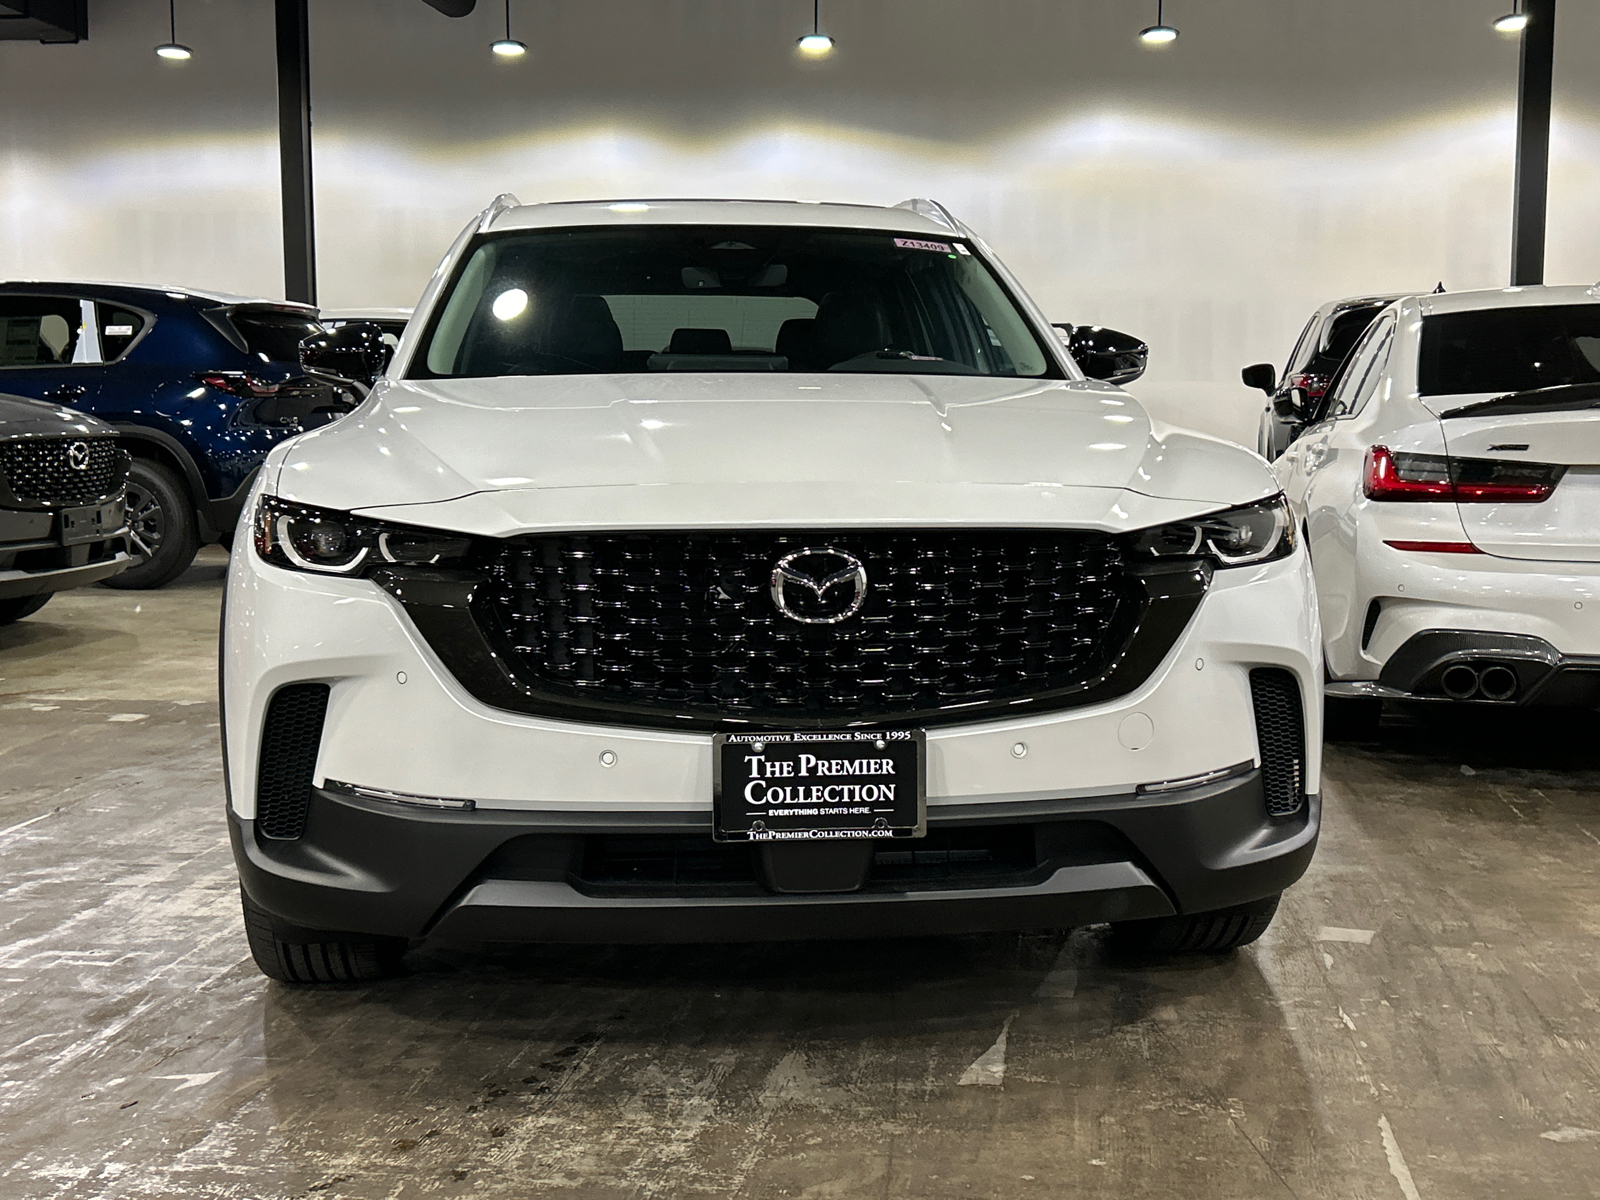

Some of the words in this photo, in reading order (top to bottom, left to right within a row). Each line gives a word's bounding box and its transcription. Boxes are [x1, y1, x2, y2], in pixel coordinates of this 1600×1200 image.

[728, 733, 791, 743] AUTOMOTIVE
[793, 732, 852, 742] EXCELLENCE
[854, 731, 883, 741] SINCE
[885, 730, 912, 740] 1995
[744, 755, 794, 778] THE
[798, 753, 896, 777] PREMIER
[744, 780, 896, 805] COLLECTION
[768, 808, 819, 817] EVERYTHING
[820, 807, 848, 815] STARTS
[849, 807, 872, 815] HERE.
[746, 829, 894, 841] THEPREMIERCOLLECTION.COM
